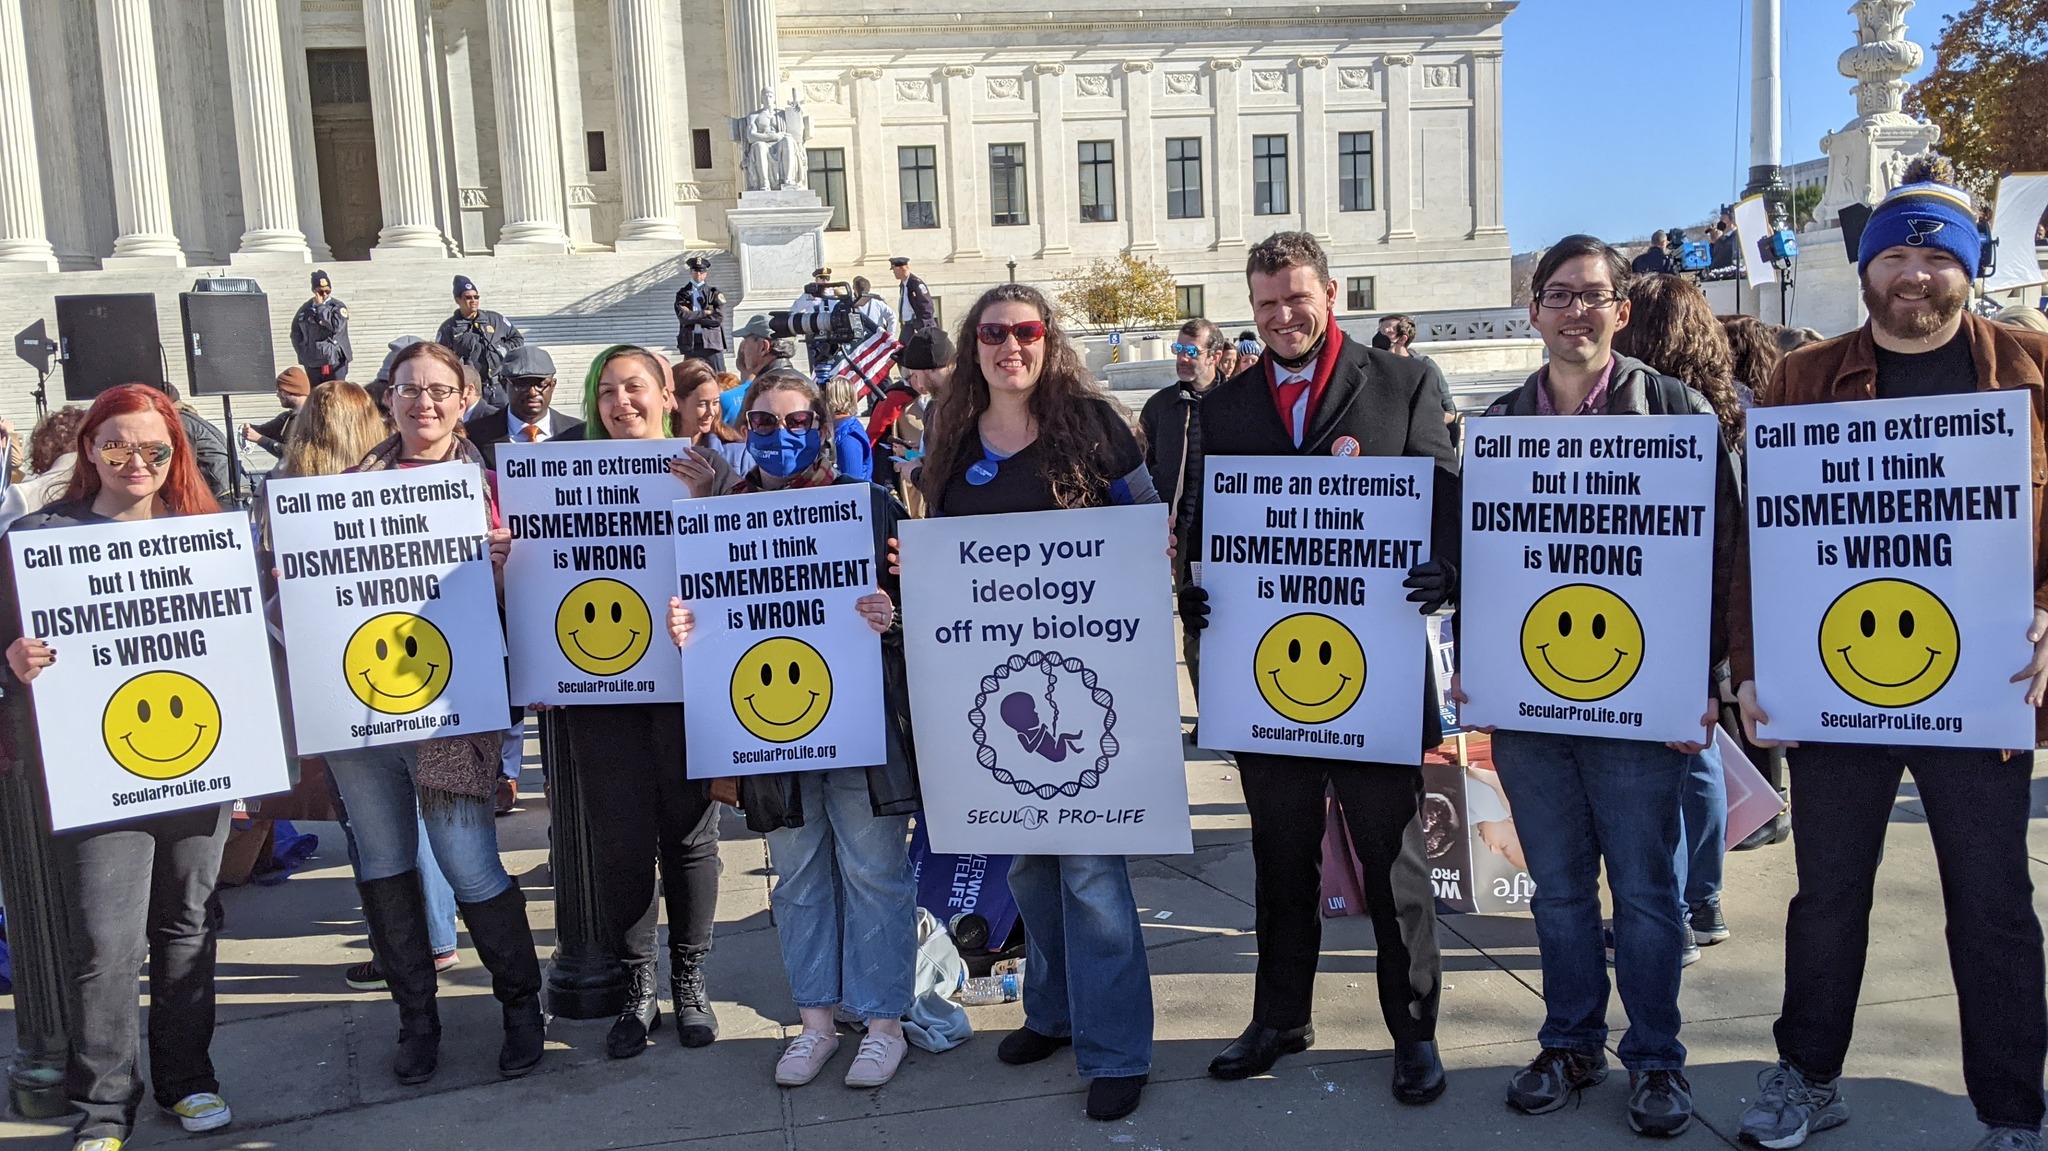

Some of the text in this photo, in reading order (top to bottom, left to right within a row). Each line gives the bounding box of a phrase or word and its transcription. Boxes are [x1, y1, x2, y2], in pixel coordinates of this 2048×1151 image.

[1755, 409, 2013, 448] Call me an extremist,
[1475, 434, 1702, 461] Call me an extremist,
[507, 455, 677, 478] Call me an extremis
[1822, 453, 1945, 483] but I think
[276, 479, 474, 514] Call me an extremist,
[555, 486, 640, 506] but I think
[1214, 472, 1420, 499] Call me an extremist,
[1533, 471, 1640, 495] but I think
[678, 500, 862, 535] Call me an extremist,
[1266, 507, 1364, 530] but I think
[1472, 502, 1705, 536] DISMEMBERMENT
[1757, 485, 2020, 528] DISMEMBERMENT
[334, 514, 429, 540] but I think
[24, 529, 241, 568] Call me an extremist,
[282, 536, 484, 579] DISMEMBERMENT
[554, 545, 646, 571] is WRONG
[729, 536, 817, 562] but I think
[960, 539, 1104, 567] Keep your
[1211, 535, 1422, 569] DISMEMBERMENT
[1525, 544, 1642, 576] is WRONG
[1818, 533, 1951, 568] is WRONG
[89, 566, 193, 595] but I think
[336, 574, 440, 606] is WRONG
[680, 559, 869, 601] DISMEMBERMENT
[972, 577, 1095, 604] ideology
[1258, 575, 1365, 605] is WRONG
[32, 587, 252, 638] DISMEMBERMENT
[728, 599, 825, 630] is WRONG
[936, 615, 1140, 646] off my biology
[92, 629, 207, 666] is WRONG
[558, 680, 654, 693] SecularProLife.org
[351, 713, 460, 737] SecularProLife.org
[1519, 702, 1642, 726] SecularProLife.org
[1821, 712, 1962, 733] SecularProLife.org
[1252, 725, 1364, 747] SecularProLife.org
[733, 746, 836, 764] SecularProLife.org
[113, 775, 231, 806] SecularProLife.org
[967, 806, 1145, 830] SECULAR PRO-LIFE
